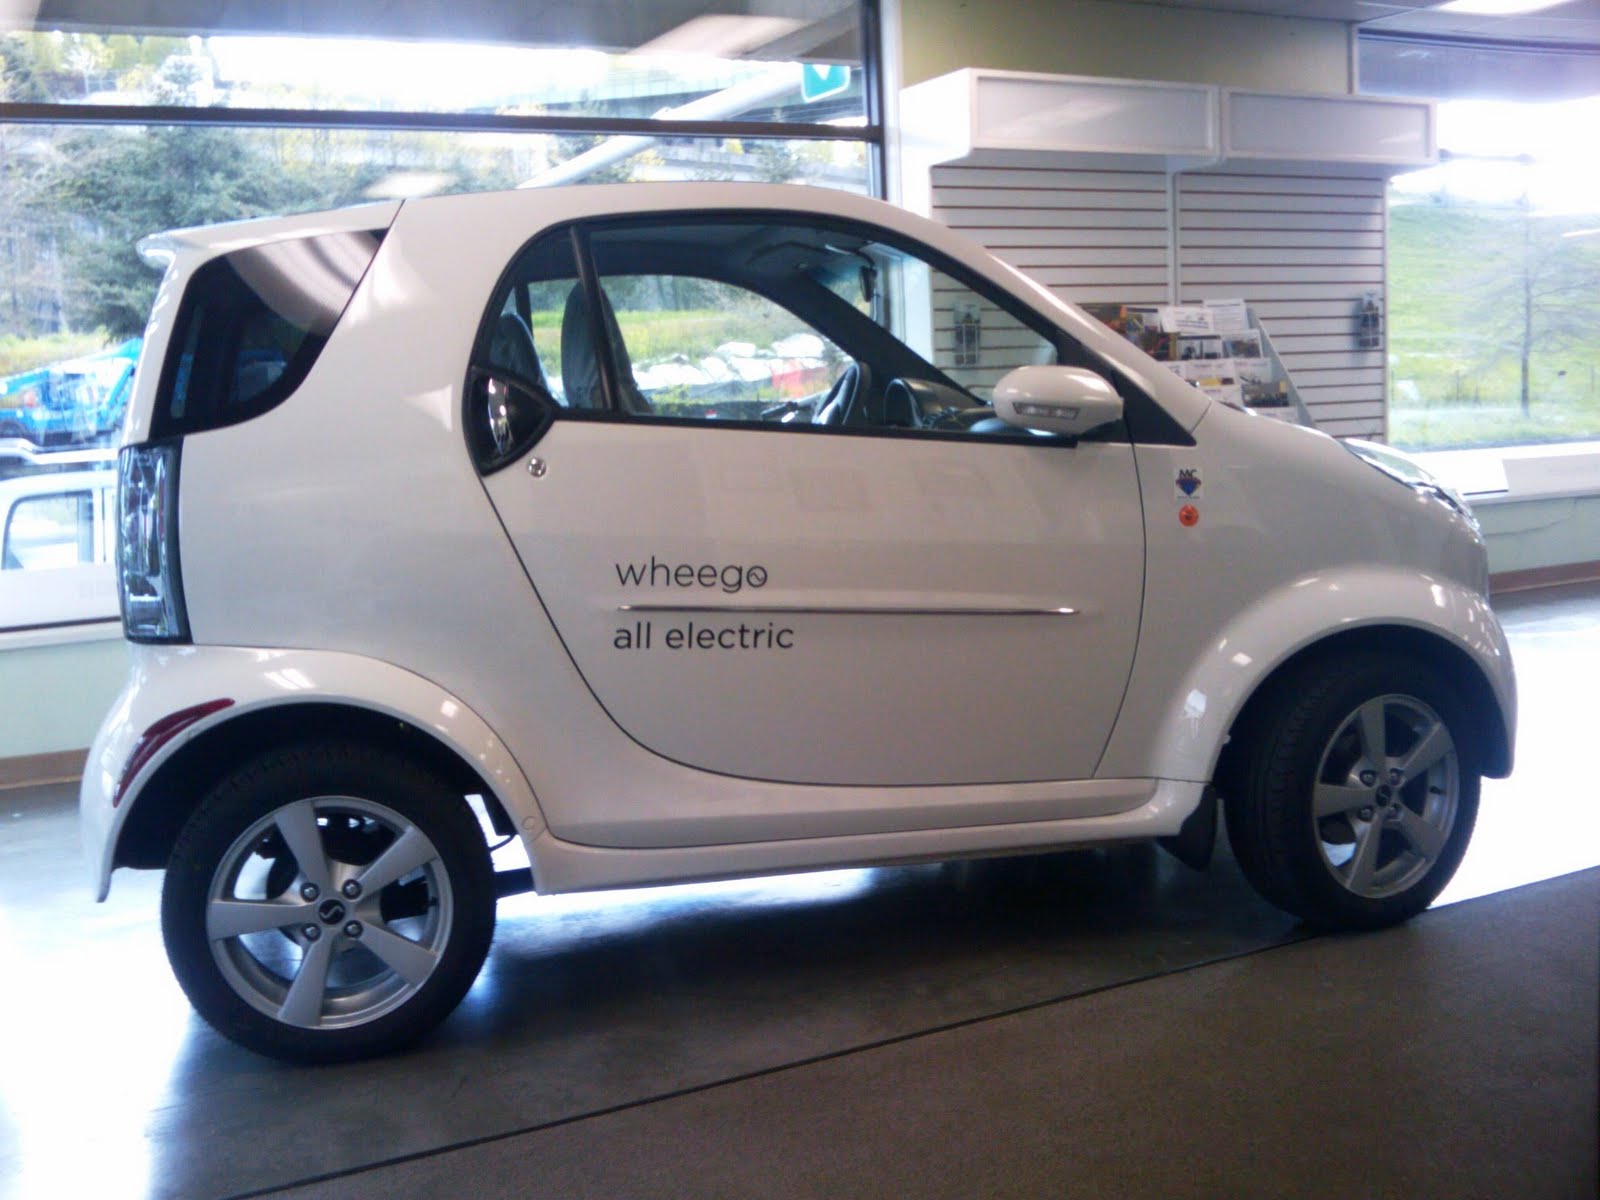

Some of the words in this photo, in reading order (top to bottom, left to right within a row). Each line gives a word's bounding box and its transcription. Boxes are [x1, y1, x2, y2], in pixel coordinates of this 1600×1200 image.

[615, 555, 769, 594] wheego
[613, 620, 652, 650] all
[664, 620, 795, 650] electric
